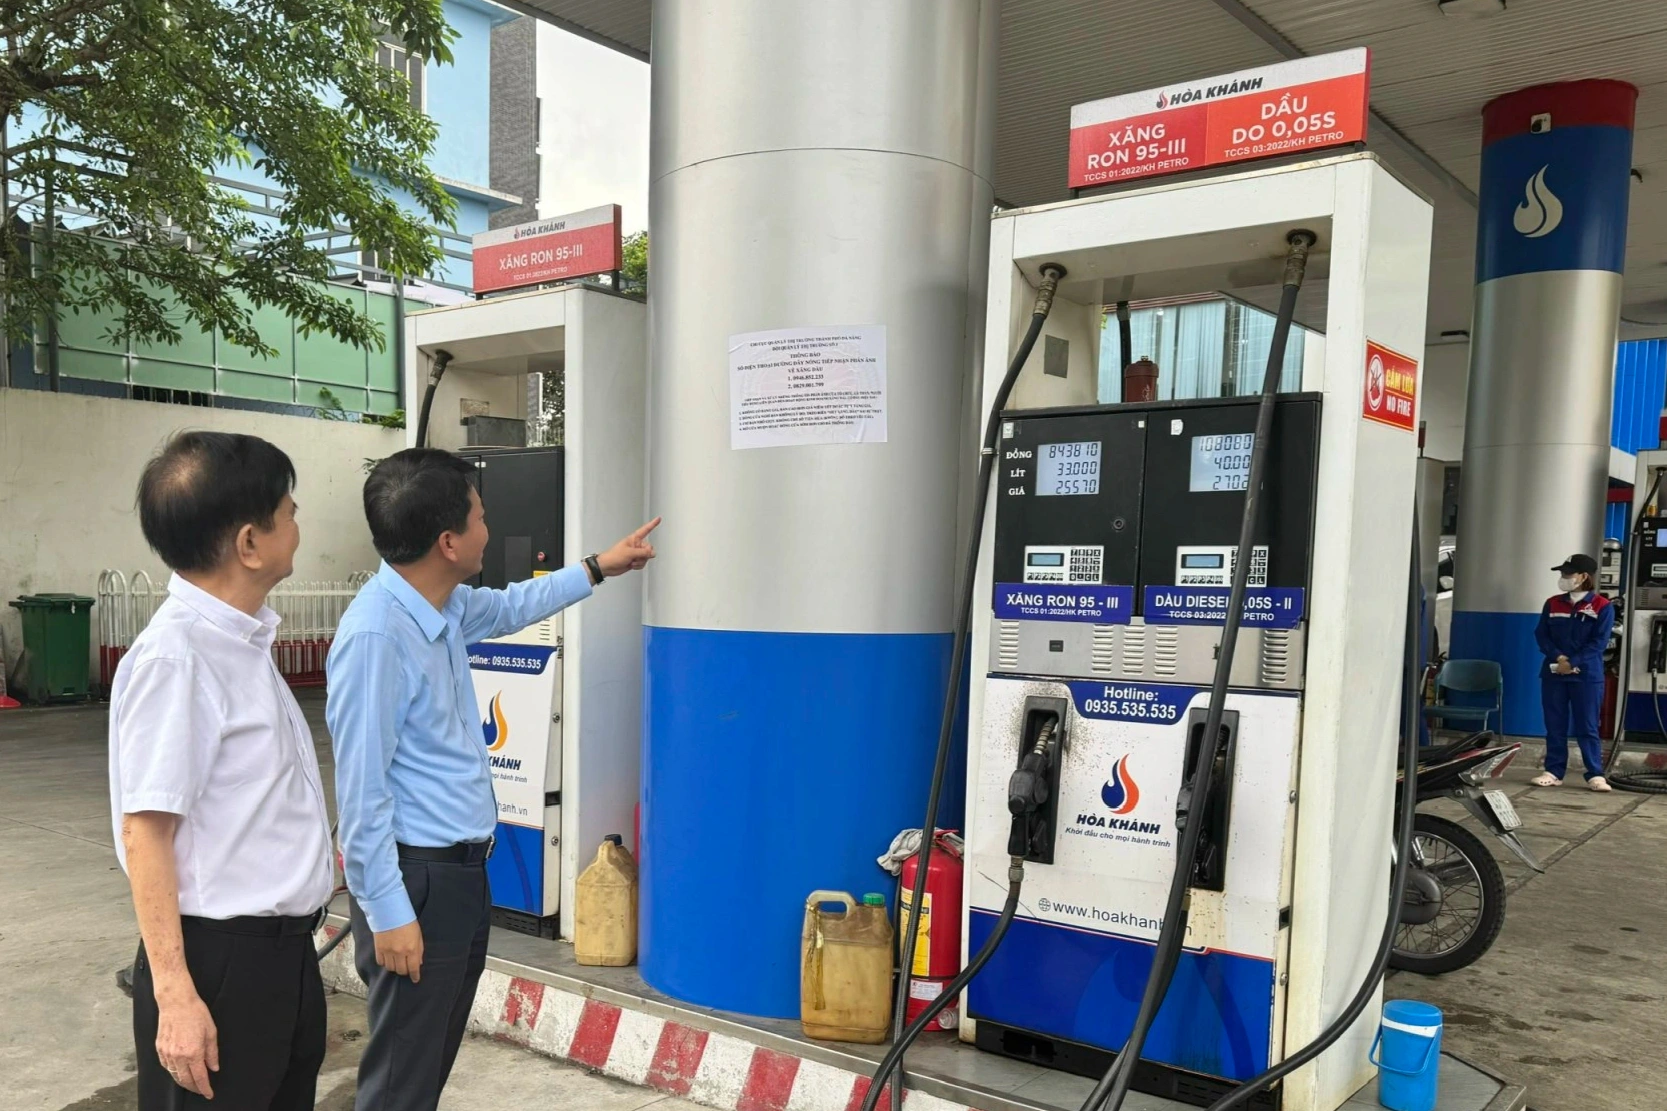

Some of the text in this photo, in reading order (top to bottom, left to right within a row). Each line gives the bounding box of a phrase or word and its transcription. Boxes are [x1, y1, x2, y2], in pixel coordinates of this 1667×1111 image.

[1170, 76, 1263, 106] HÒA KHÁNH
[1261, 92, 1308, 120] DẦU
[1108, 123, 1165, 147] XĂNG
[1232, 111, 1336, 145] DO 0,05S
[1224, 130, 1344, 158] TCCS 03:2022/KH PETRO
[1087, 138, 1186, 170] RON 95-III
[1084, 157, 1189, 182] TCCS 01:2022/KH PETRO
[520, 221, 566, 238] HÒA KHÁNH
[499, 244, 583, 271] XĂNG RON 95-III
[1387, 395, 1412, 417] NO FIRE
[1006, 448, 1033, 459] ĐỒNG
[1049, 442, 1099, 459] 843810
[1057, 461, 1098, 476] 33.000
[1214, 454, 1251, 470] 40.00
[1010, 467, 1027, 478] LÍT
[1008, 486, 1026, 496] GIÁ
[1056, 479, 1097, 495] 25570
[1006, 592, 1043, 606] XĂNG
[1047, 595, 1076, 607] RON
[1080, 596, 1095, 608] 95
[1107, 596, 1119, 609] III
[1242, 597, 1272, 611] ,05S
[1284, 597, 1292, 610] II
[1021, 606, 1102, 617] TCCS 01:2022/HK PETRO
[1169, 610, 1275, 621] TCCS 03:2022 PETRO
[467, 655, 542, 669] otline: 0935.535.535
[1104, 685, 1159, 701] Hotline:
[1085, 698, 1176, 719] 0935.535.535
[1076, 813, 1161, 834] HÒA KHÁNH
[1099, 832, 1114, 840] cho
[1115, 835, 1130, 843] mọi
